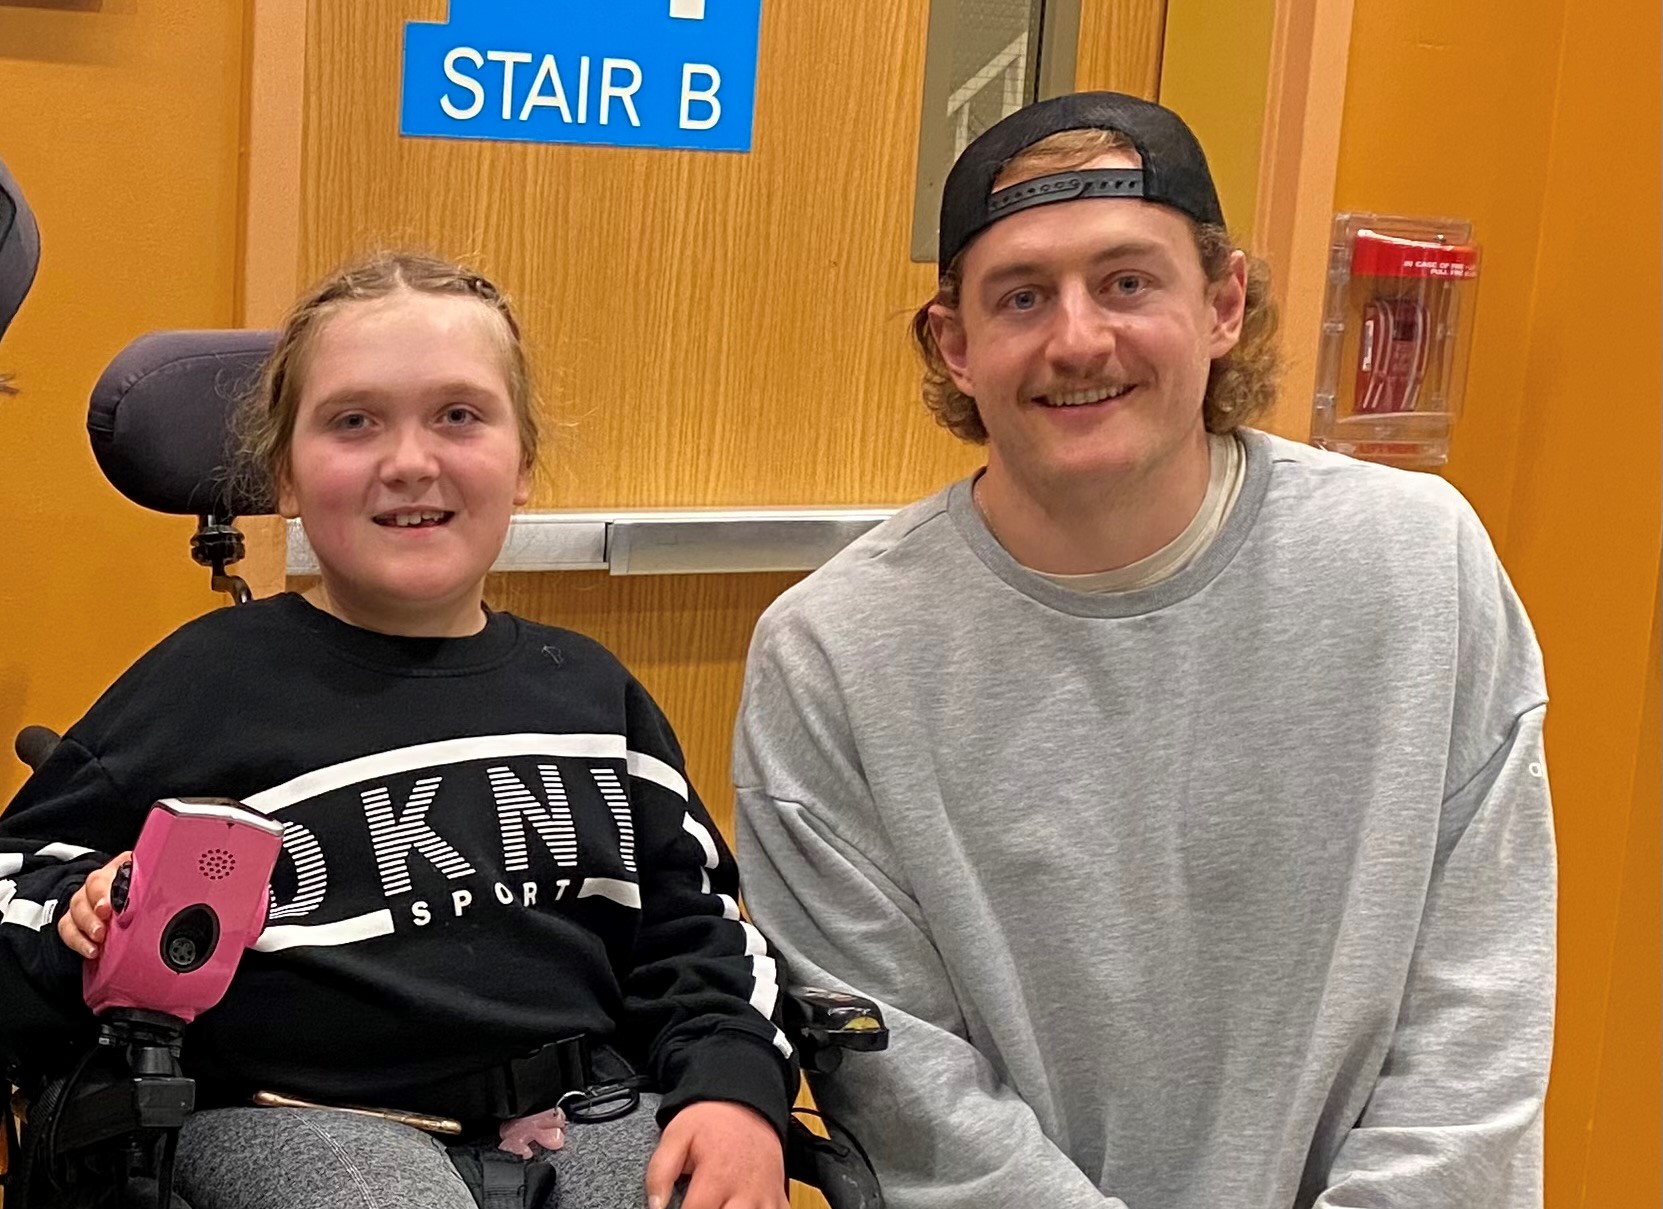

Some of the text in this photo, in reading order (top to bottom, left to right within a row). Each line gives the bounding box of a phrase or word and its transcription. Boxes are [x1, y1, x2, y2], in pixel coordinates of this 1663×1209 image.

[439, 46, 723, 131] STAIR B
[410, 878, 572, 927] SPORT
